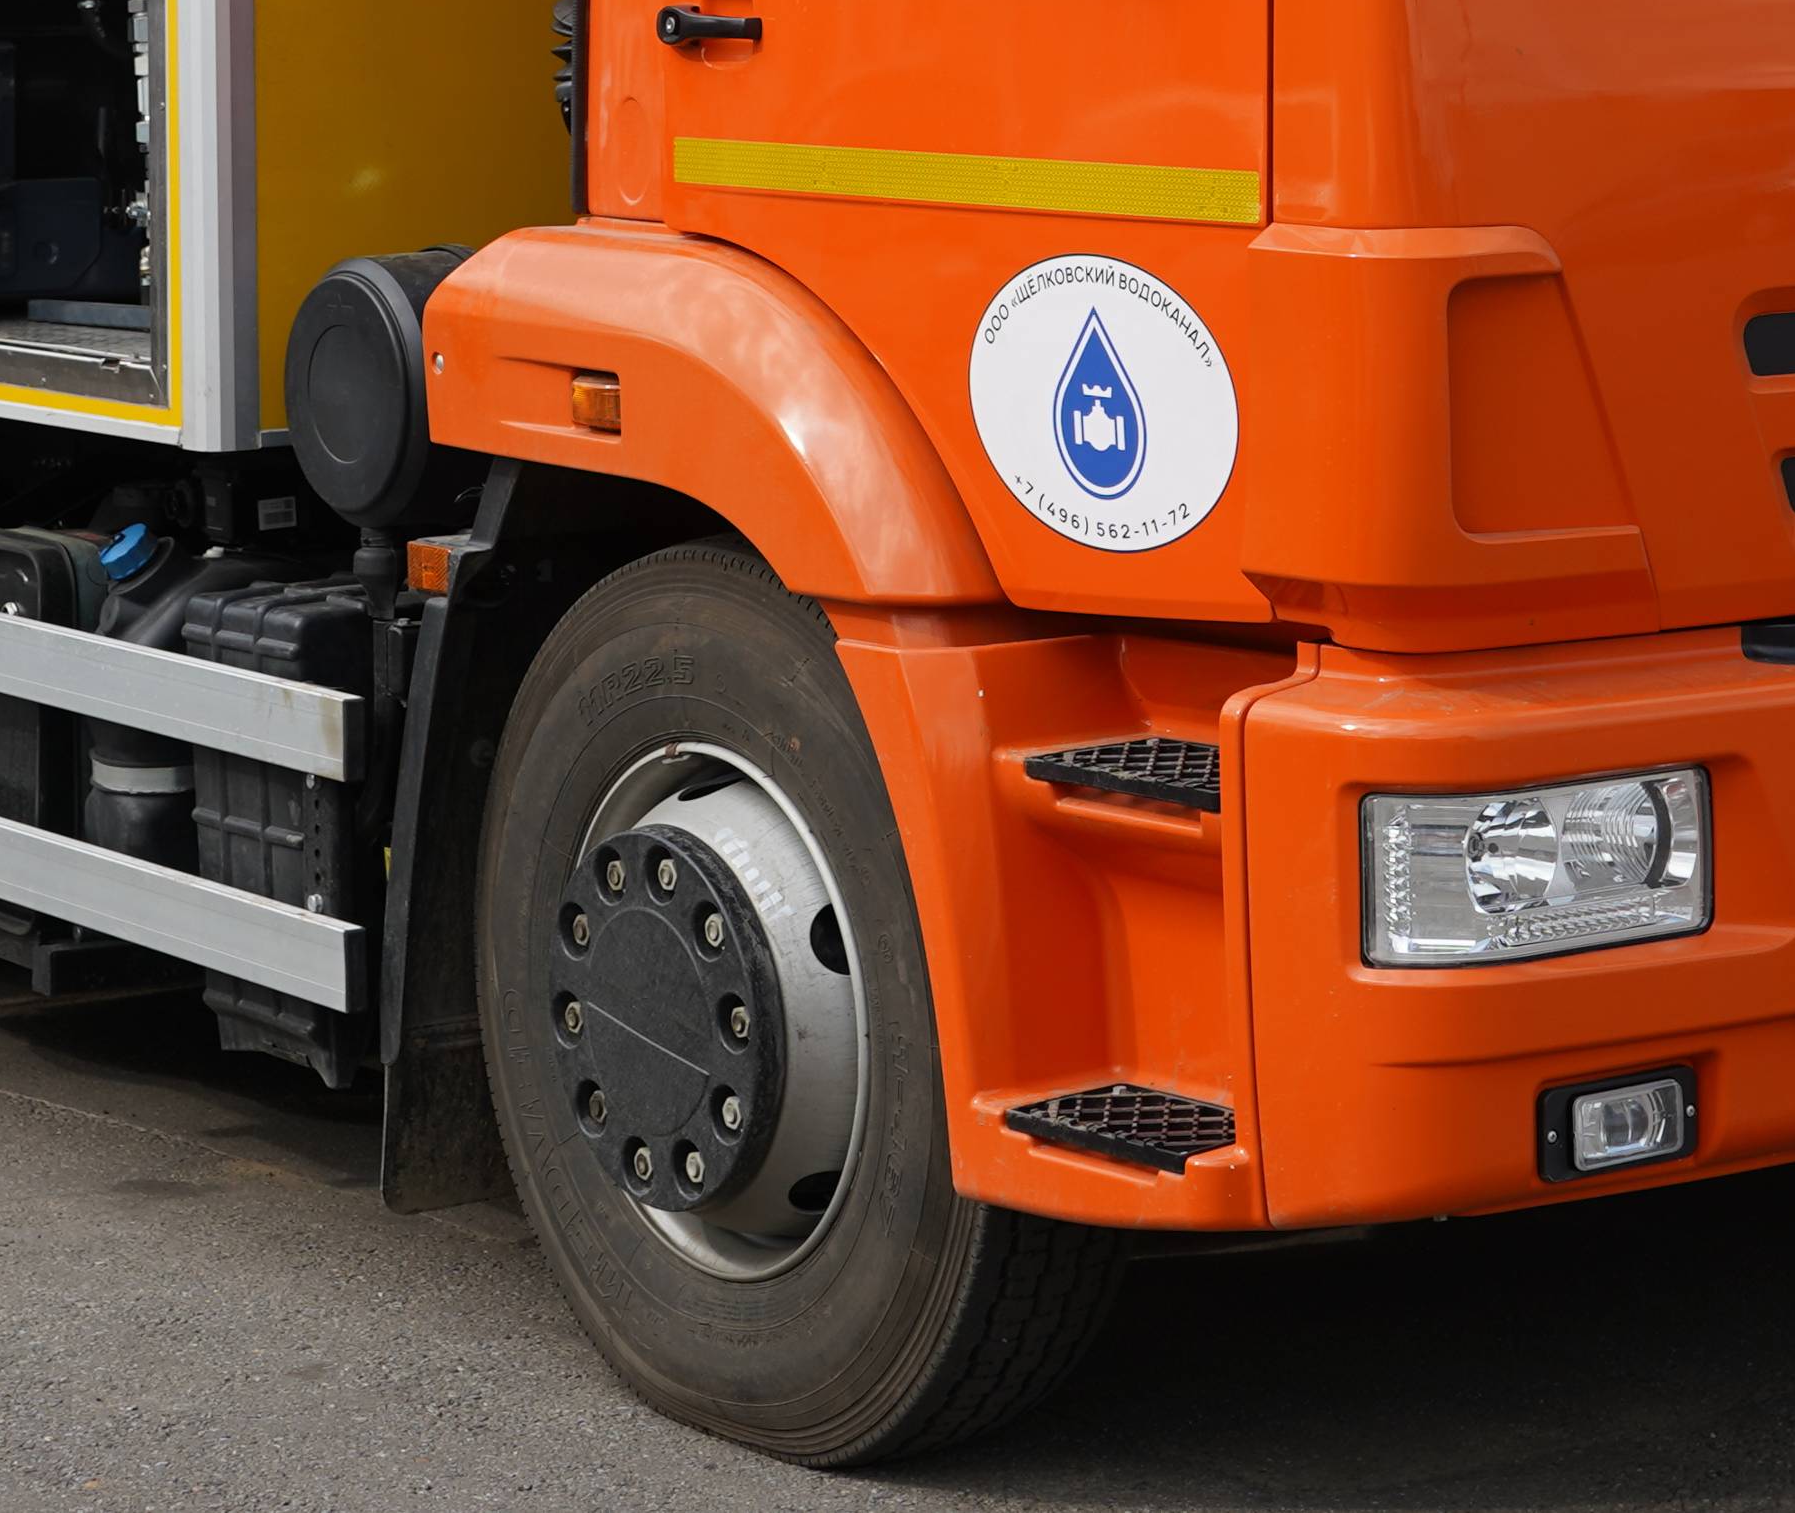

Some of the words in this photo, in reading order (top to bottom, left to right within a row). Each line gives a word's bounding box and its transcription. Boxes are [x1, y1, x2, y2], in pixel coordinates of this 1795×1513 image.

[984, 303, 1010, 345] ООО
[1010, 264, 1115, 310] «ЩЁЛКОВСКИЙ
[1119, 273, 1214, 368] ВОДОКАНАЛ»
[1038, 493, 1090, 536] (496)
[1096, 502, 1190, 539] 562-11-72
